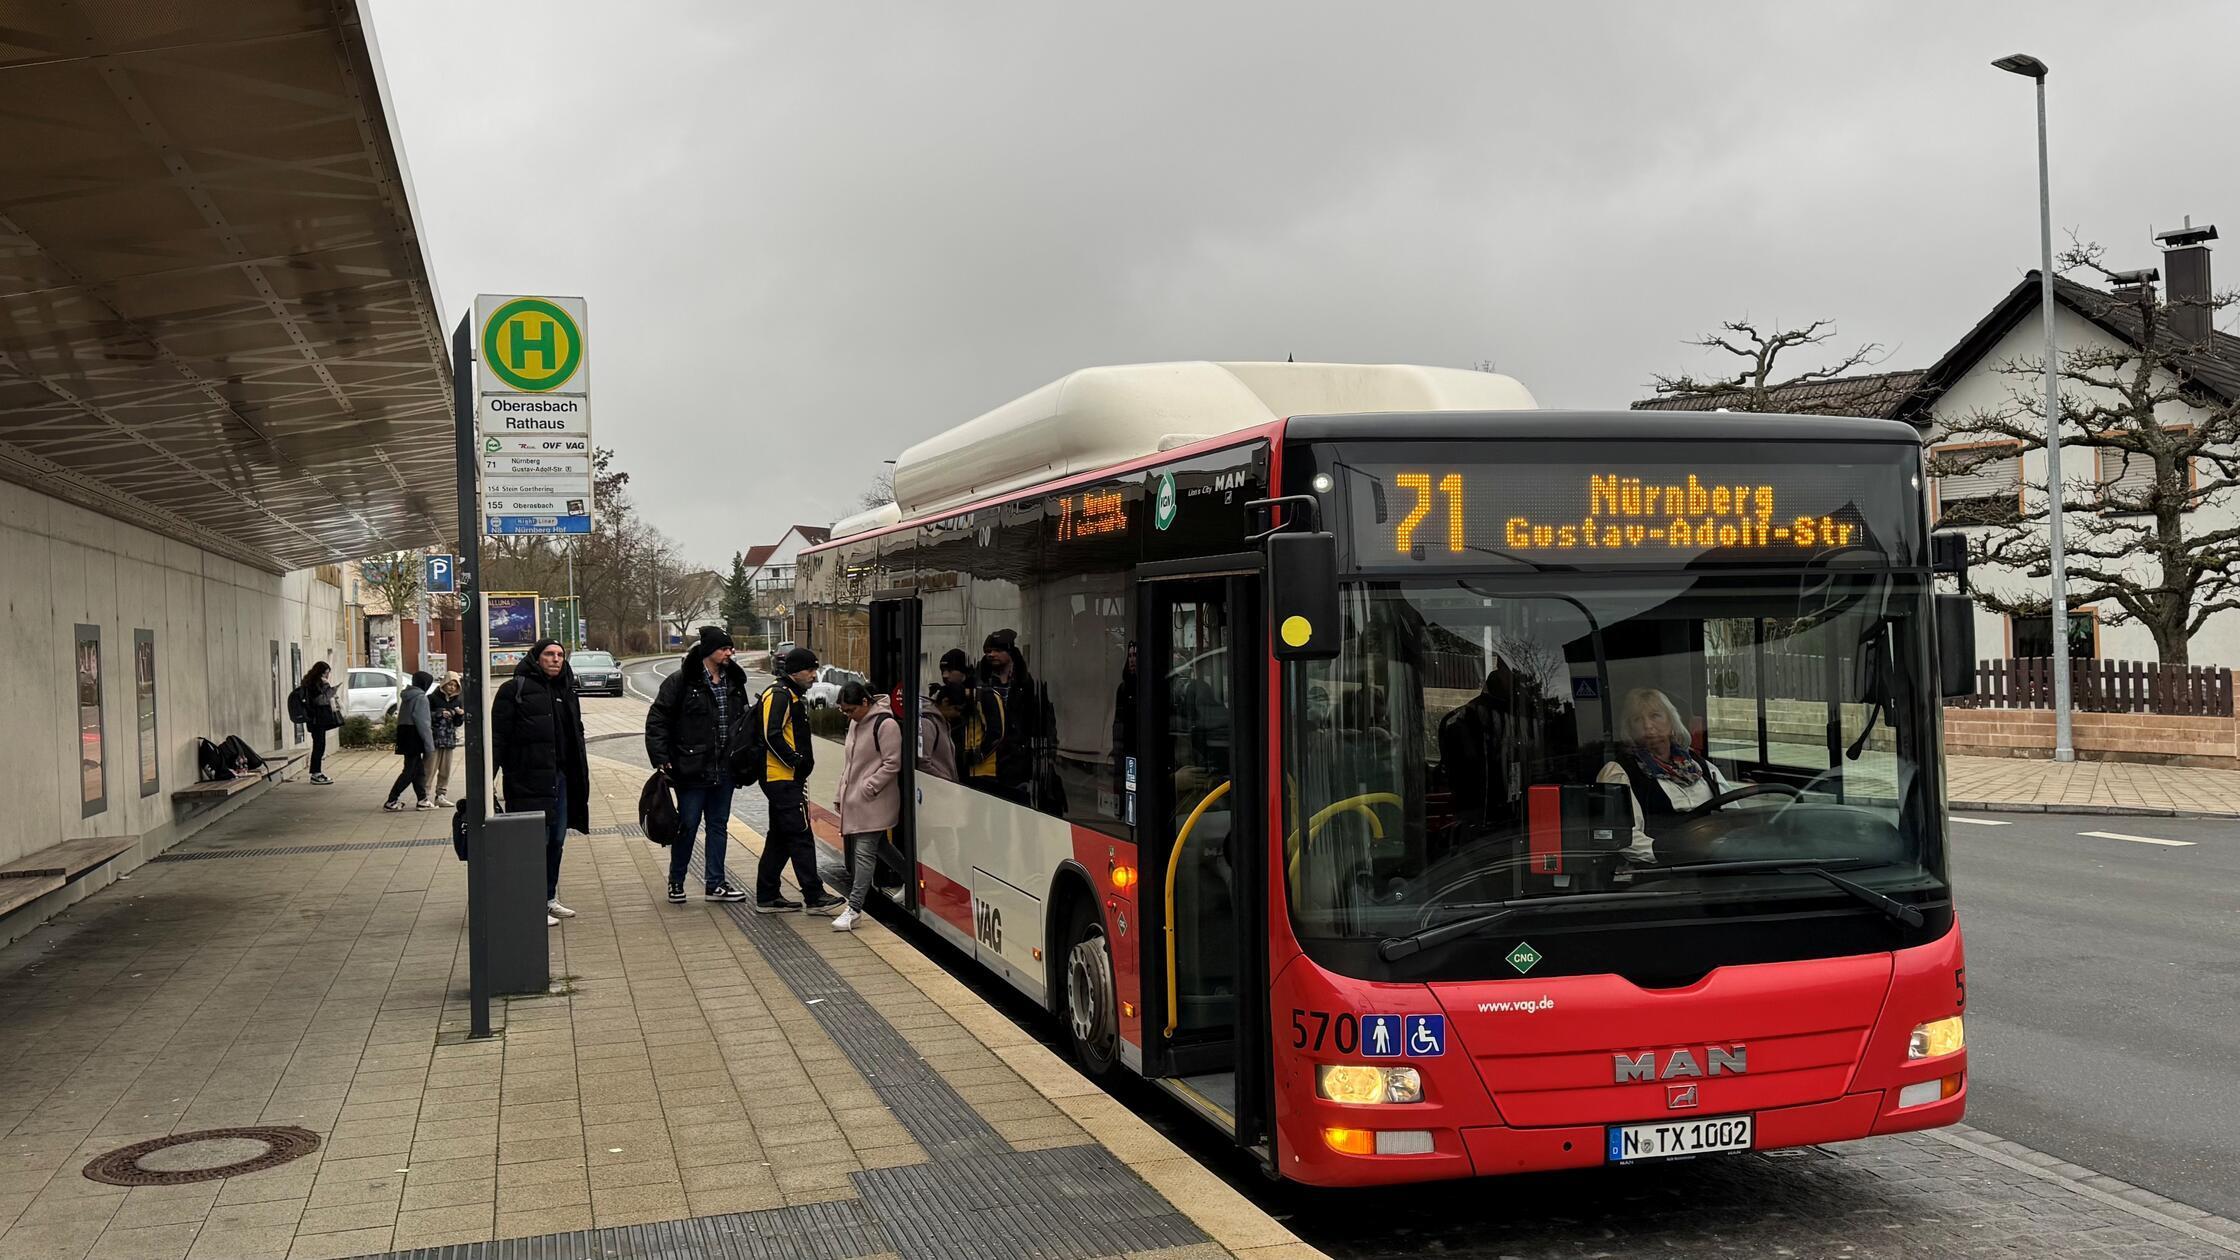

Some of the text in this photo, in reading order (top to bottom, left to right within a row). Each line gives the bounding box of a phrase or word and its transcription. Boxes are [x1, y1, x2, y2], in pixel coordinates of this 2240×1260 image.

[509, 320, 556, 370] H
[490, 399, 578, 413] Oberasbach
[505, 417, 565, 430] Rathaus
[1202, 485, 1213, 495] City
[1215, 470, 1246, 492] MAN
[487, 501, 503, 509] 155
[1590, 474, 1774, 521] Nürnberg
[1058, 496, 1072, 542] 71
[1395, 472, 1464, 552] 71
[1505, 516, 1855, 547] Gustav-Adolf-Str
[433, 562, 447, 580] P
[976, 897, 1002, 955] VAG
[1513, 953, 1534, 963] CNG
[1478, 994, 1555, 1014] www.vag.de
[1292, 1008, 1359, 1054] 570
[1614, 1044, 1746, 1082] MAN
[1612, 1147, 1619, 1155] D
[1623, 1120, 1748, 1156] N TX 1002
